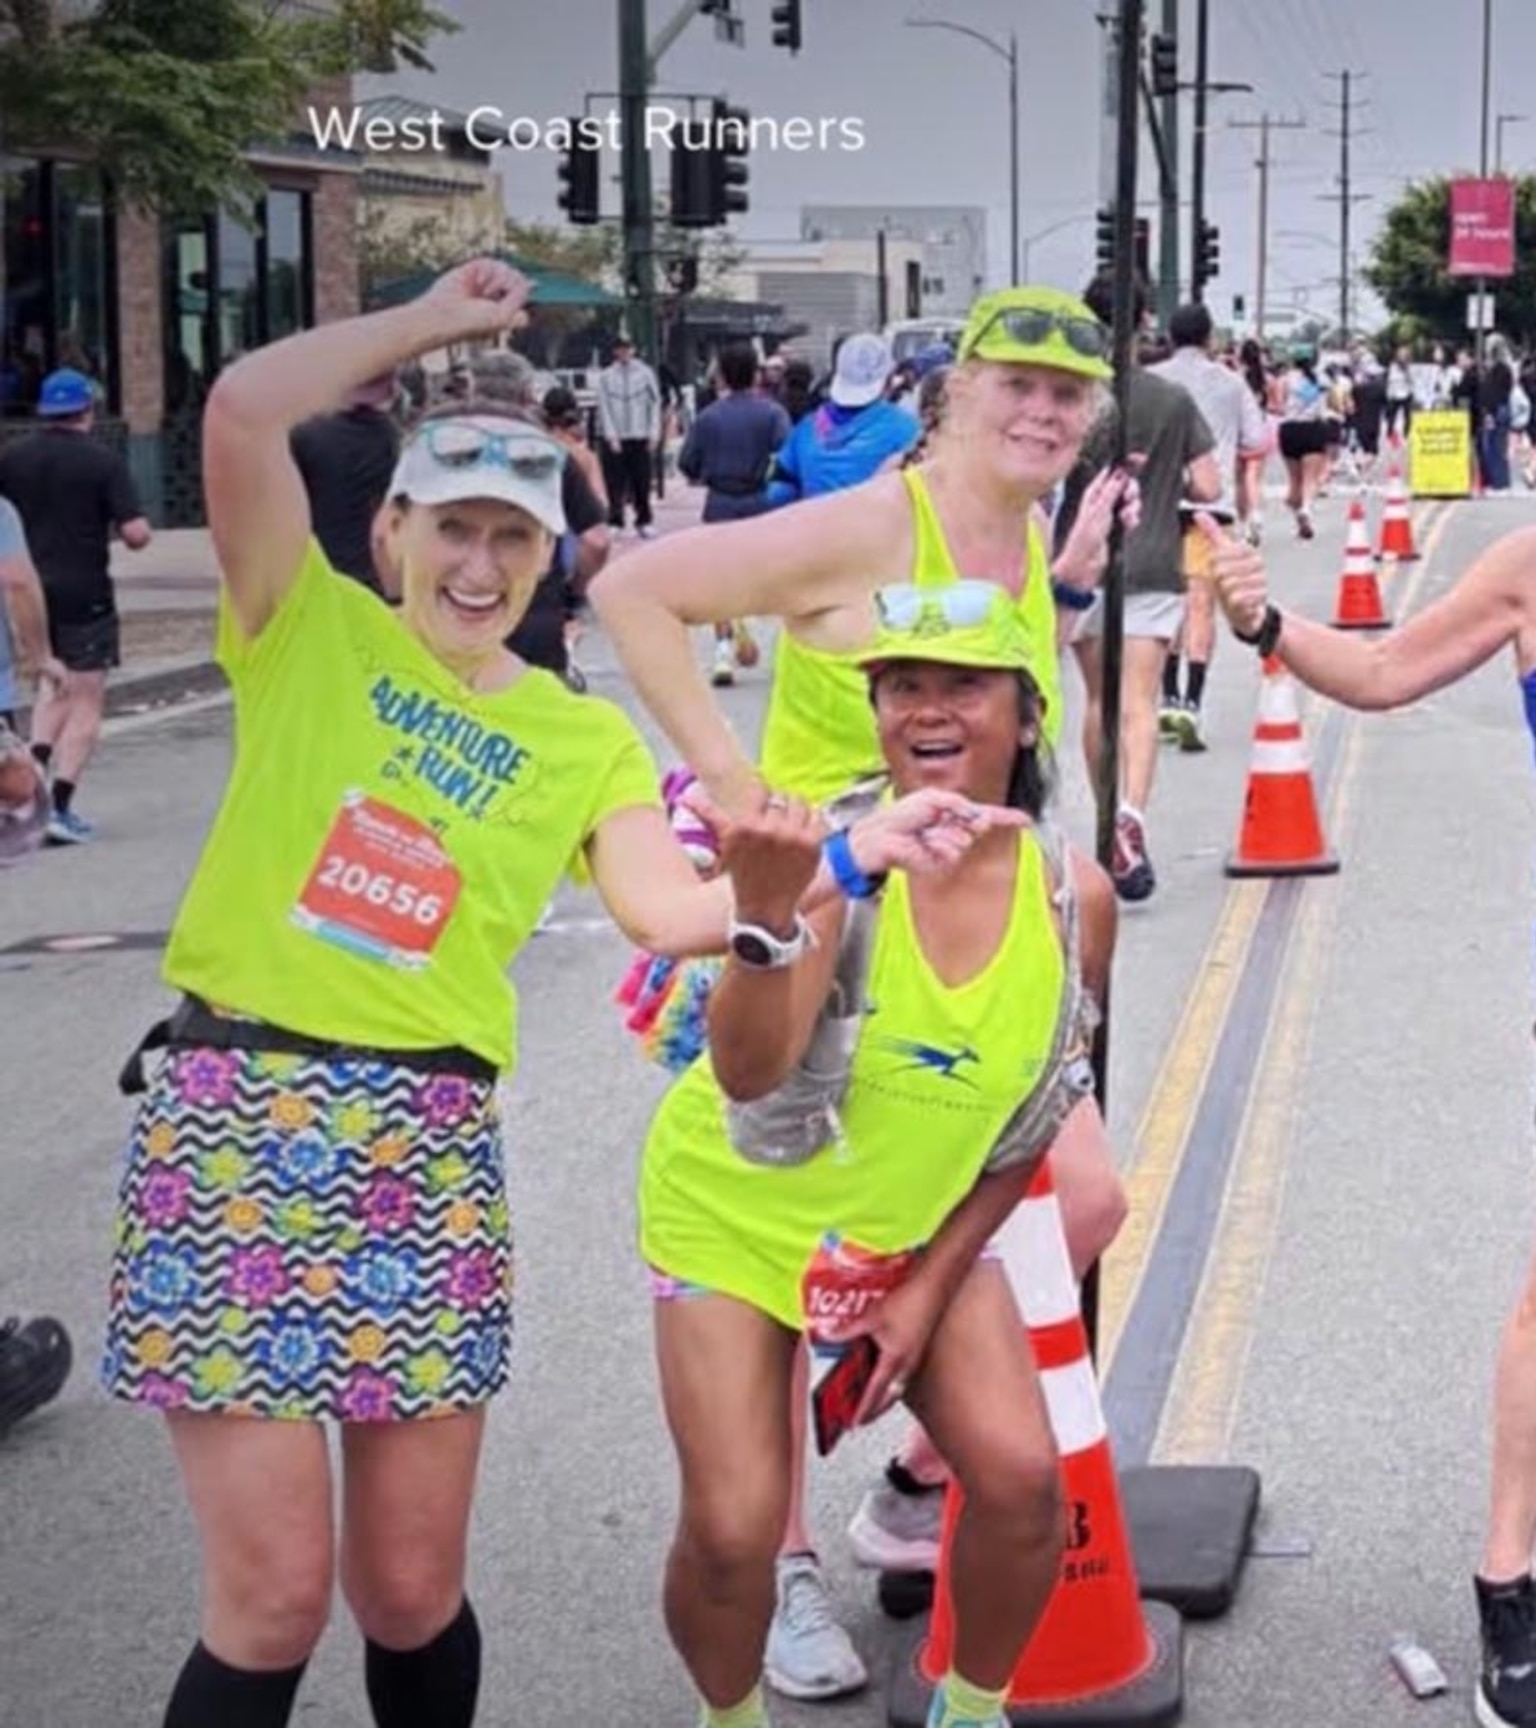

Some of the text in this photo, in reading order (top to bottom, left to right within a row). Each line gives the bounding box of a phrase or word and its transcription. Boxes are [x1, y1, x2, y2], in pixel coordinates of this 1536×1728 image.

[370, 674, 532, 786] ADVENTURE
[414, 744, 500, 820] RUN!
[317, 854, 443, 926] 20656
[808, 1286, 884, 1318] 1021
